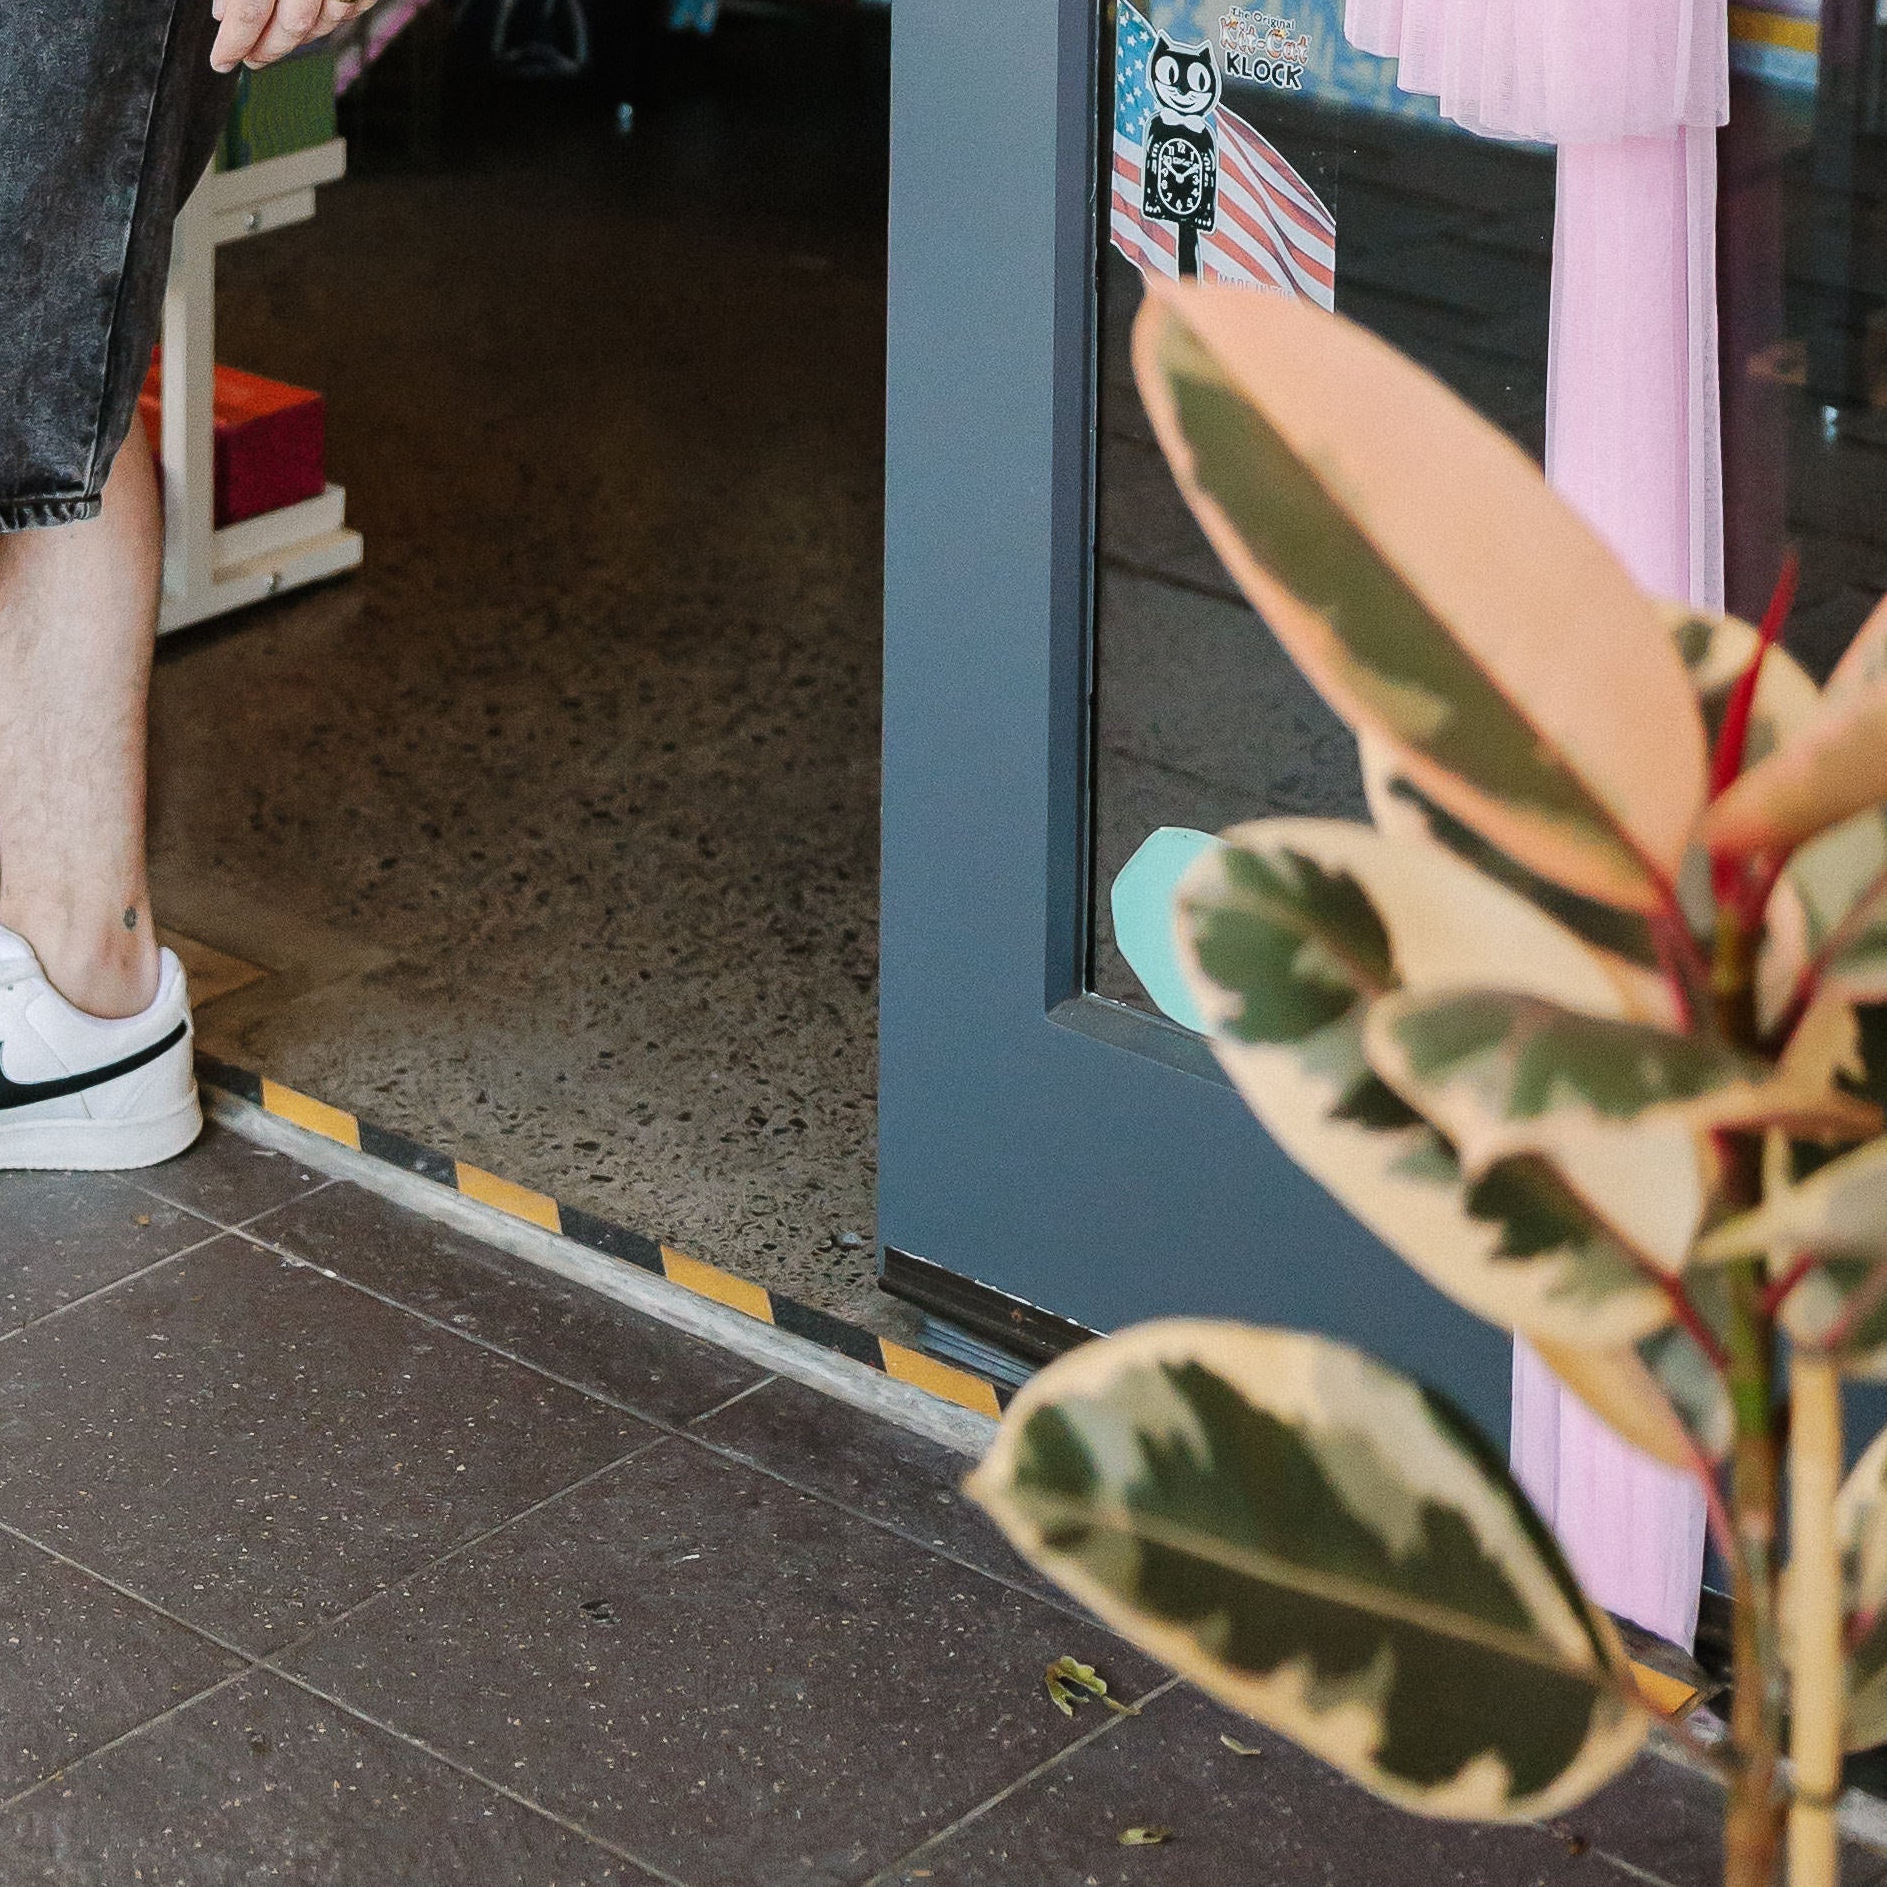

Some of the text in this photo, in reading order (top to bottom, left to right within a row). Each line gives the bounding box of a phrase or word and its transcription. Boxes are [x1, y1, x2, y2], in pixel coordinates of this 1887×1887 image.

[1231, 6, 1295, 30] The Original
[1219, 16, 1308, 63] Kit-Cat
[1226, 51, 1302, 88] KLOCK
